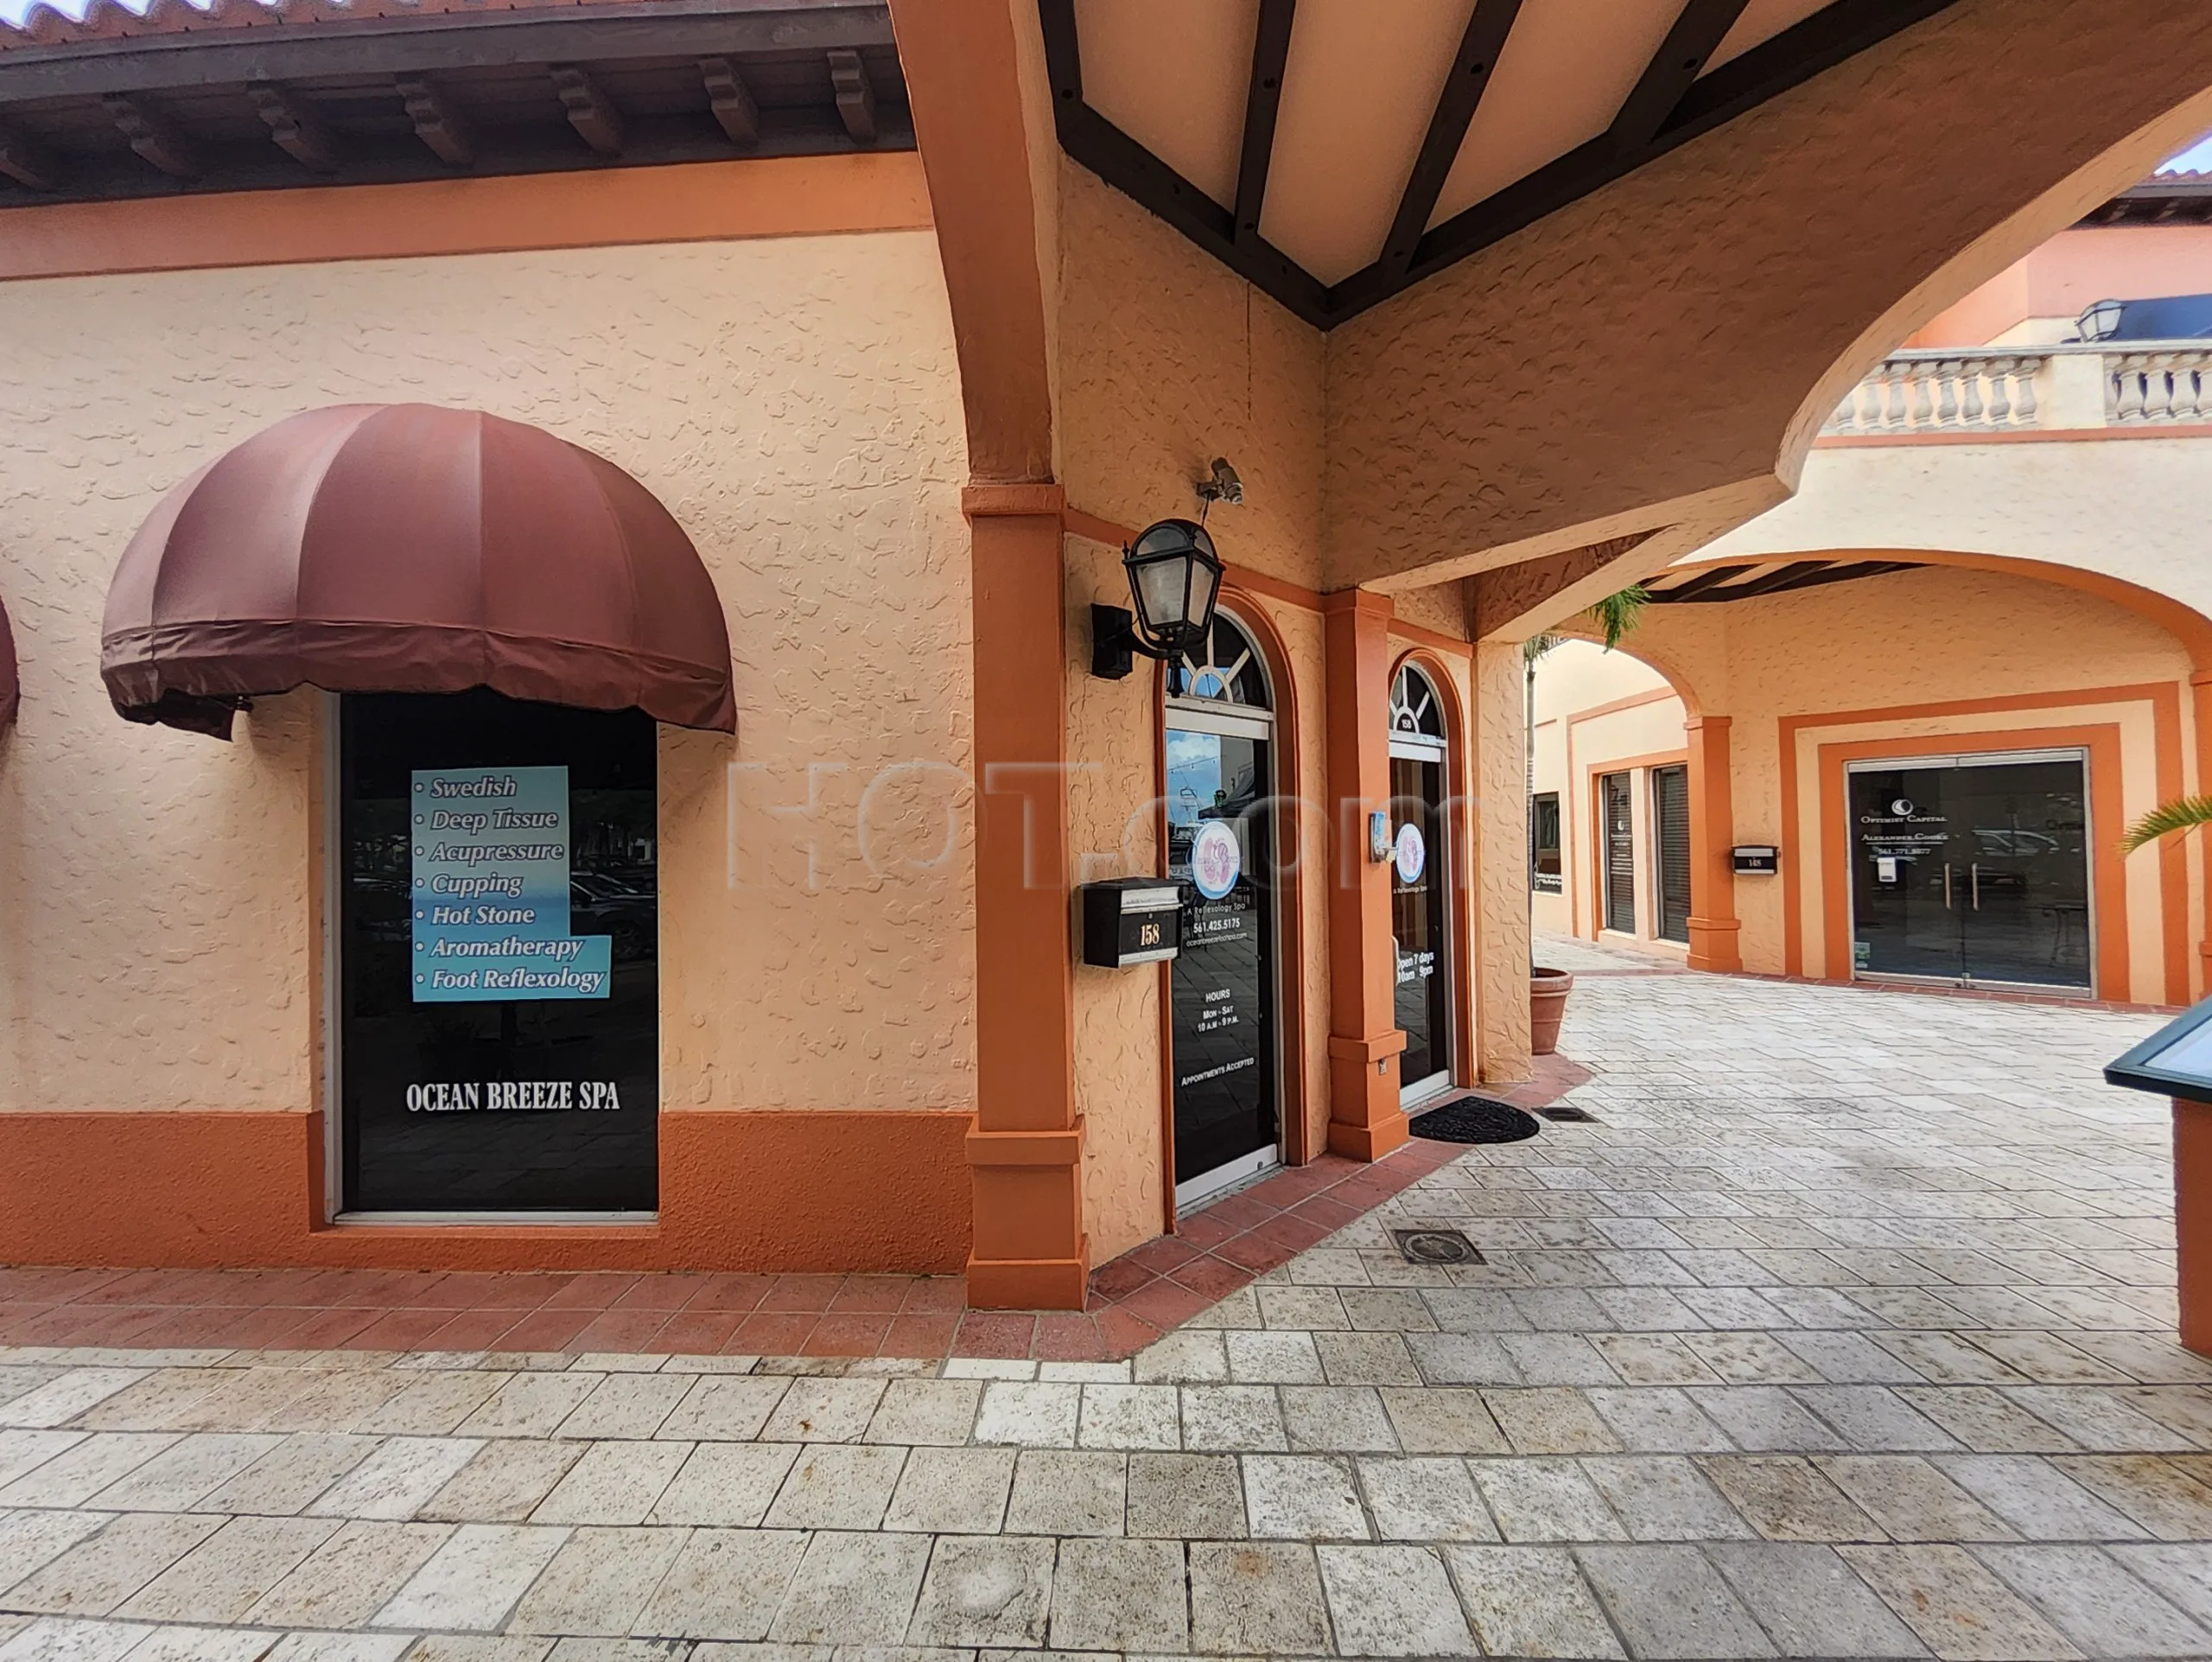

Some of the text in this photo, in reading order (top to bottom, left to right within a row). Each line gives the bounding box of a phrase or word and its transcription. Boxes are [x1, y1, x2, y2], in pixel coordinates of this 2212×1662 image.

[1402, 719, 1412, 729] 158
[430, 776, 517, 798] Swedish
[430, 809, 558, 835] Deep Tissue
[429, 843, 564, 867] Acupressure
[431, 873, 524, 899] Cupping
[431, 906, 536, 925] Hot Stone
[1194, 904, 1232, 915] Reflexology
[1233, 902, 1246, 911] Spa
[1141, 923, 1160, 946] 158
[1193, 917, 1241, 933] 561.425.5175
[429, 934, 586, 962] Aromatherapy
[1397, 952, 1434, 971] Open 7 days
[431, 966, 605, 994] Foot Reflexology
[1420, 965, 1433, 978] 9pm
[1205, 989, 1230, 1003] HOURS
[1198, 1022, 1205, 1032] 10
[1222, 1017, 1227, 1026] 9
[1225, 1057, 1255, 1073] ACCEPTED
[406, 1081, 621, 1111] OCEAN BREEZE SPA
